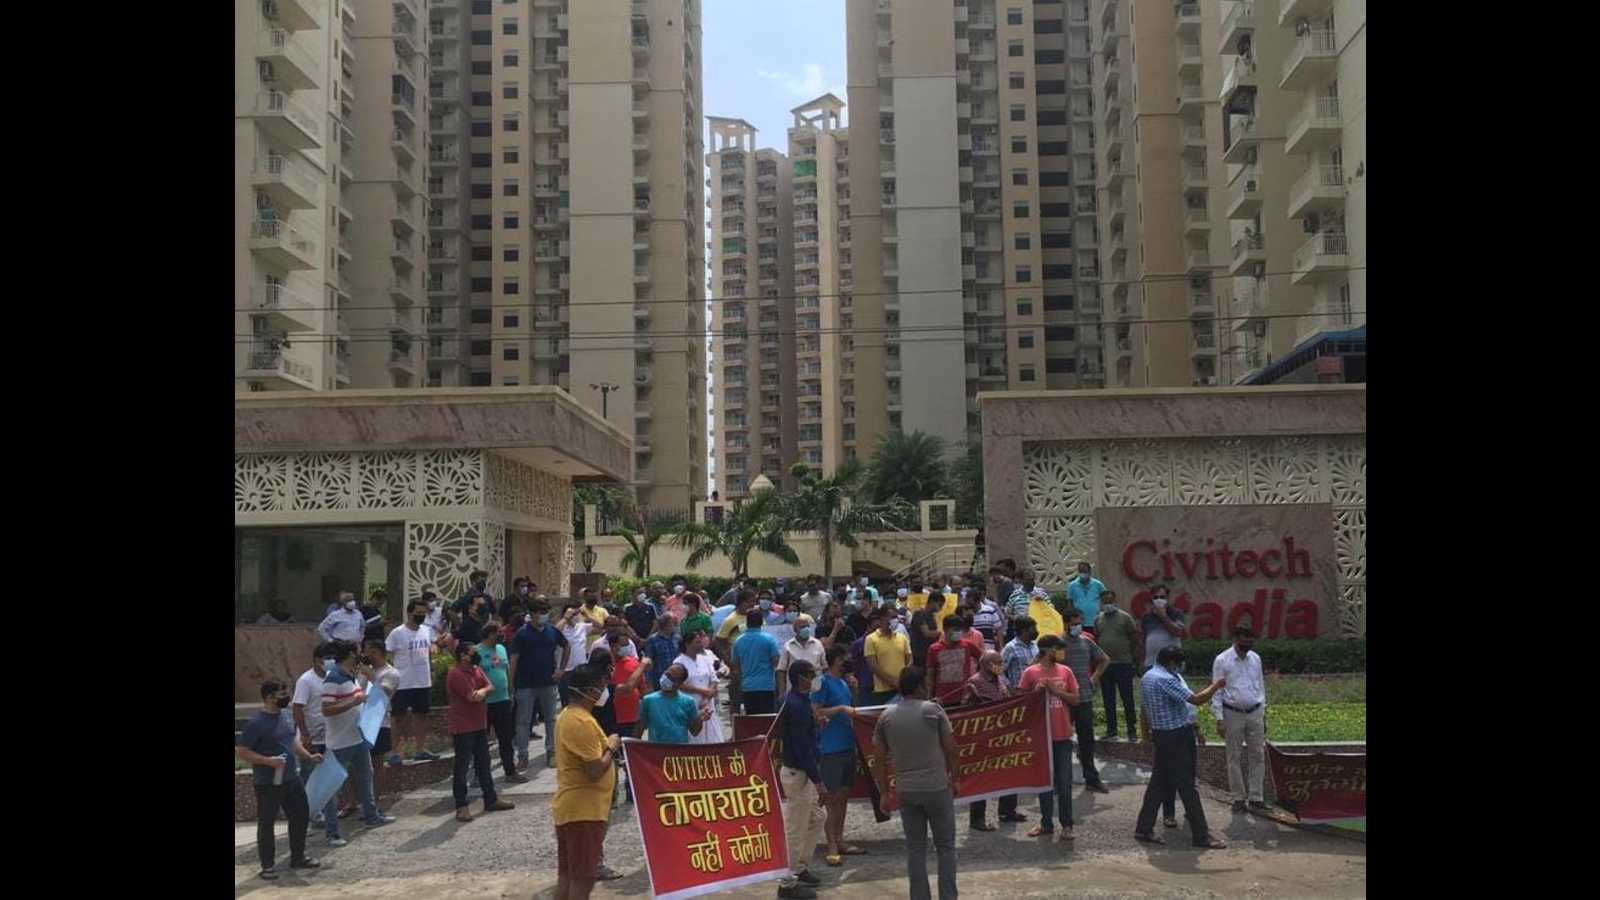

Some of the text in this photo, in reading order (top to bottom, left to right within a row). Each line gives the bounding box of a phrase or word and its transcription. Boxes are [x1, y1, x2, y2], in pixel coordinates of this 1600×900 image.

[1122, 535, 1313, 582] Civitech
[1130, 588, 1321, 640] adia
[662, 755, 725, 782] CIVITECH
[655, 774, 771, 827] तानाशाही
[726, 822, 772, 865] चलेगी
